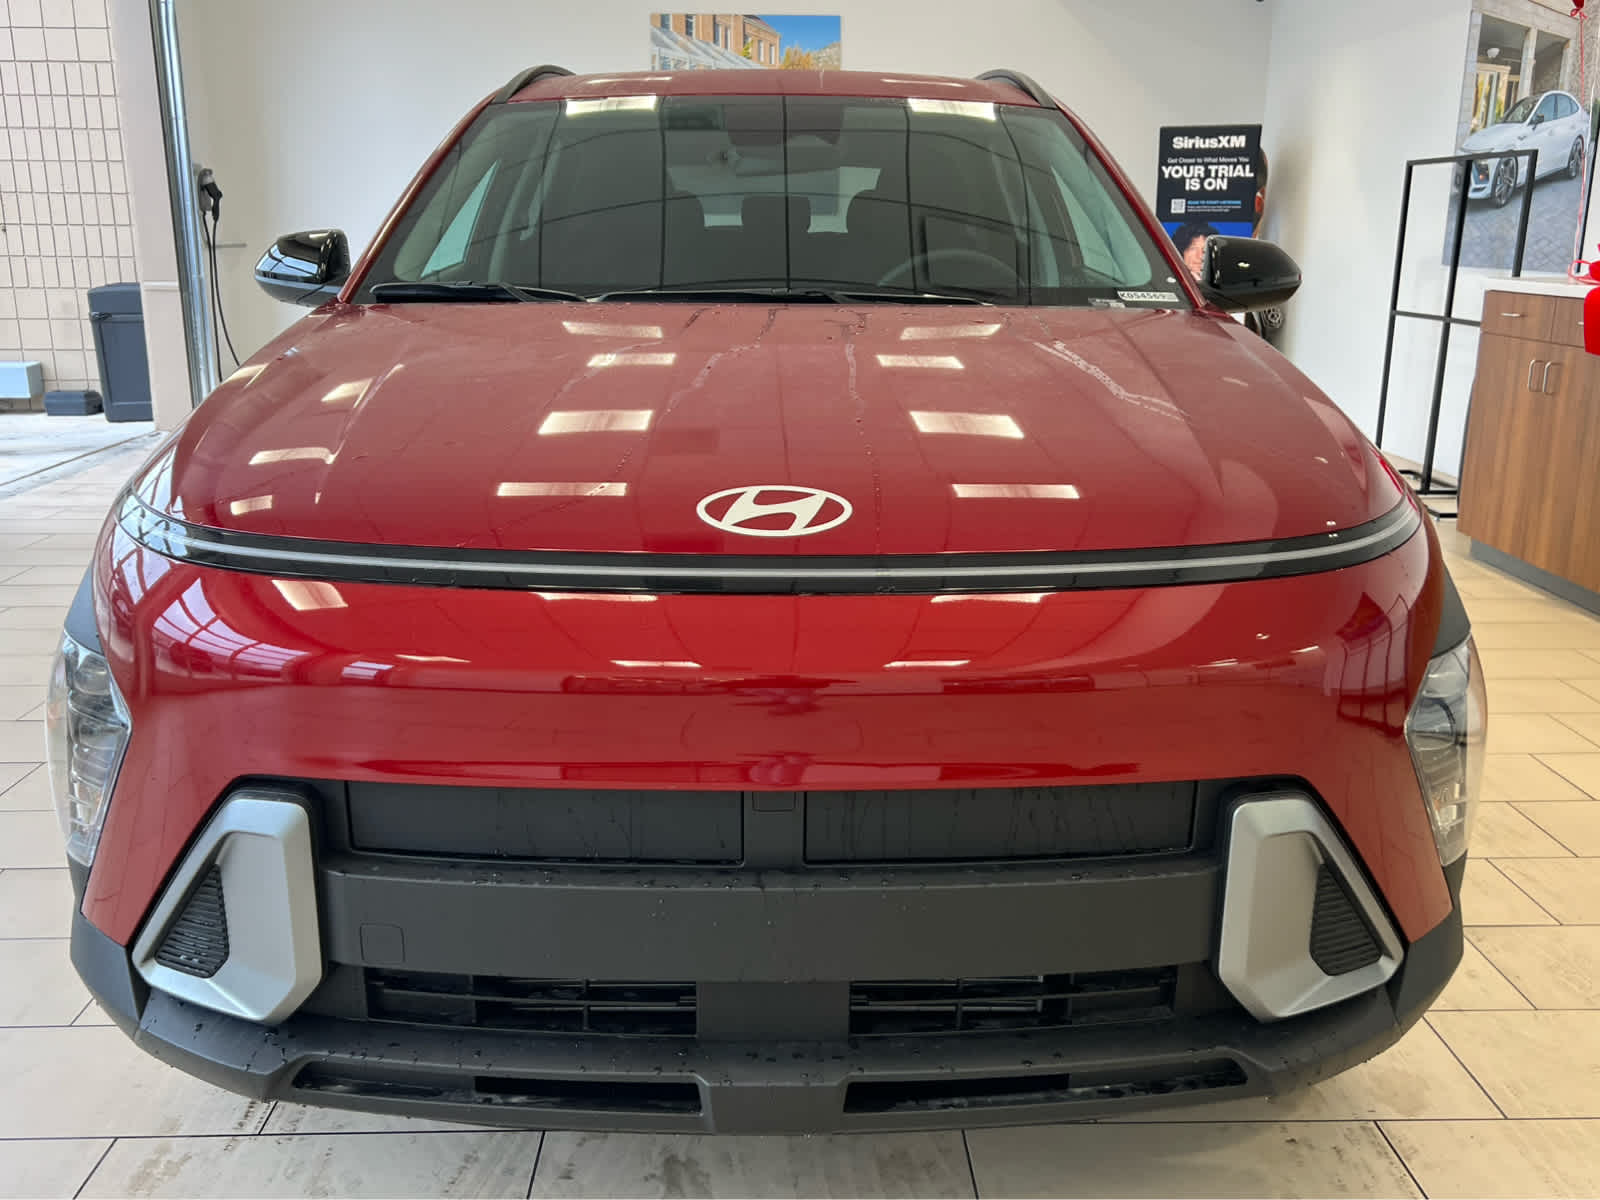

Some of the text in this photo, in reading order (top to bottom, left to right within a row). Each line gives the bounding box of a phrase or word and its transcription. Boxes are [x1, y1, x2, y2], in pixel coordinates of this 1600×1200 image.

[1172, 135, 1246, 149] SiriusXM
[1161, 164, 1254, 179] YOUR TRIAL
[1185, 178, 1228, 191] IS ON
